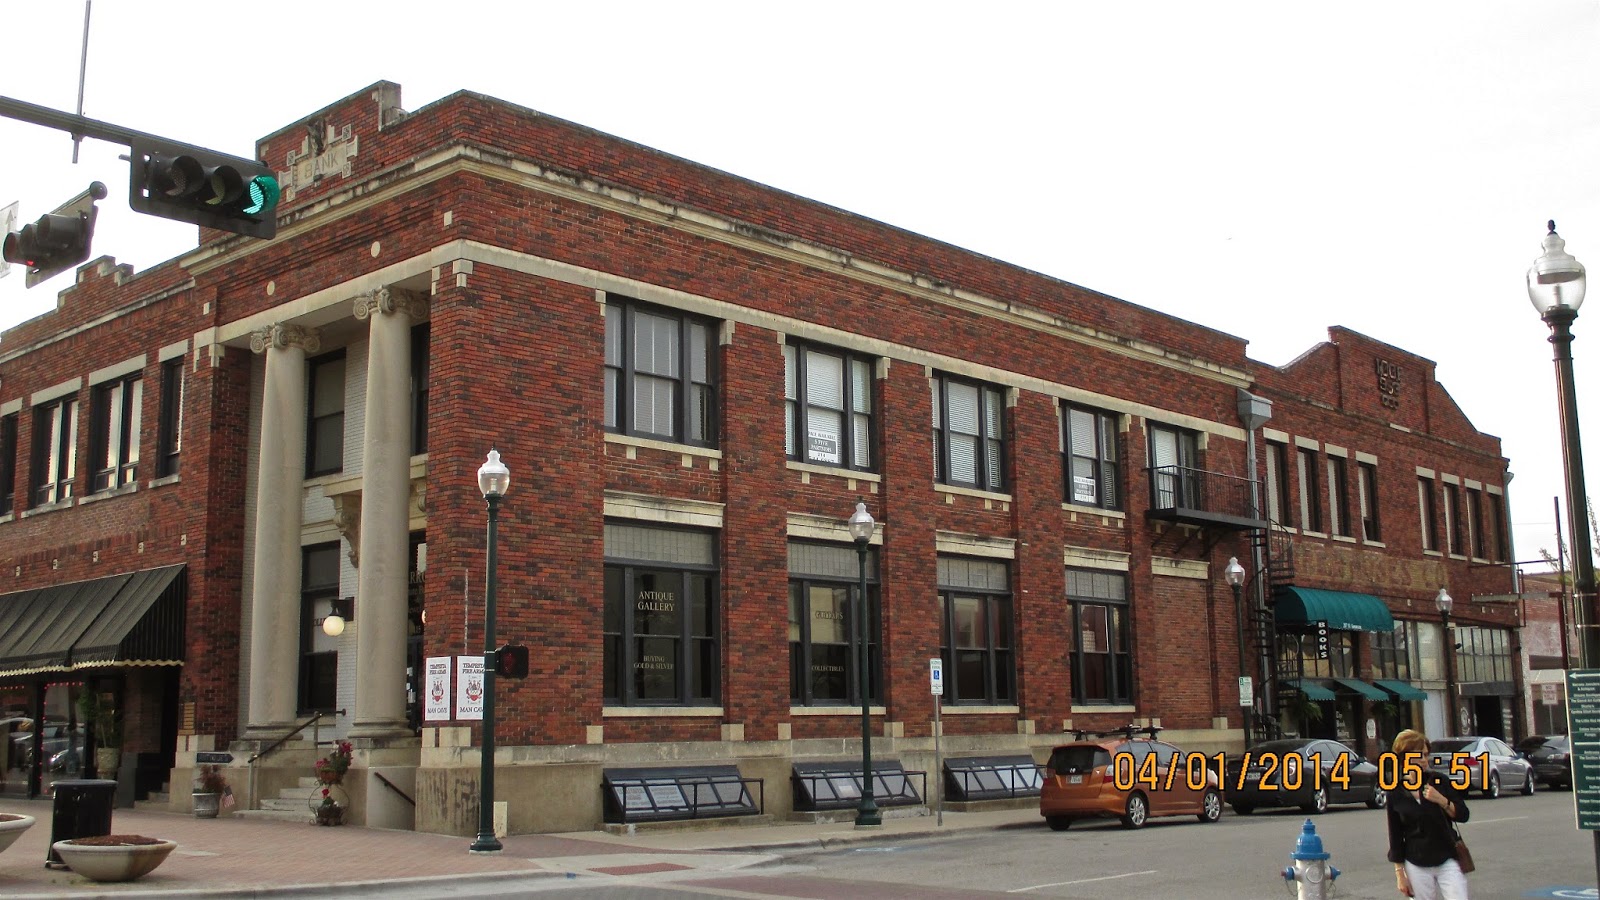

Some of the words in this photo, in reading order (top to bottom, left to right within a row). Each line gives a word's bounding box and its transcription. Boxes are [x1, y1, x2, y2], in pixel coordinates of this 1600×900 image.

[304, 152, 338, 178] BANK
[638, 591, 674, 601] ANTIQUE
[637, 601, 676, 612] GALLERY
[1318, 621, 1328, 659] BOOKS
